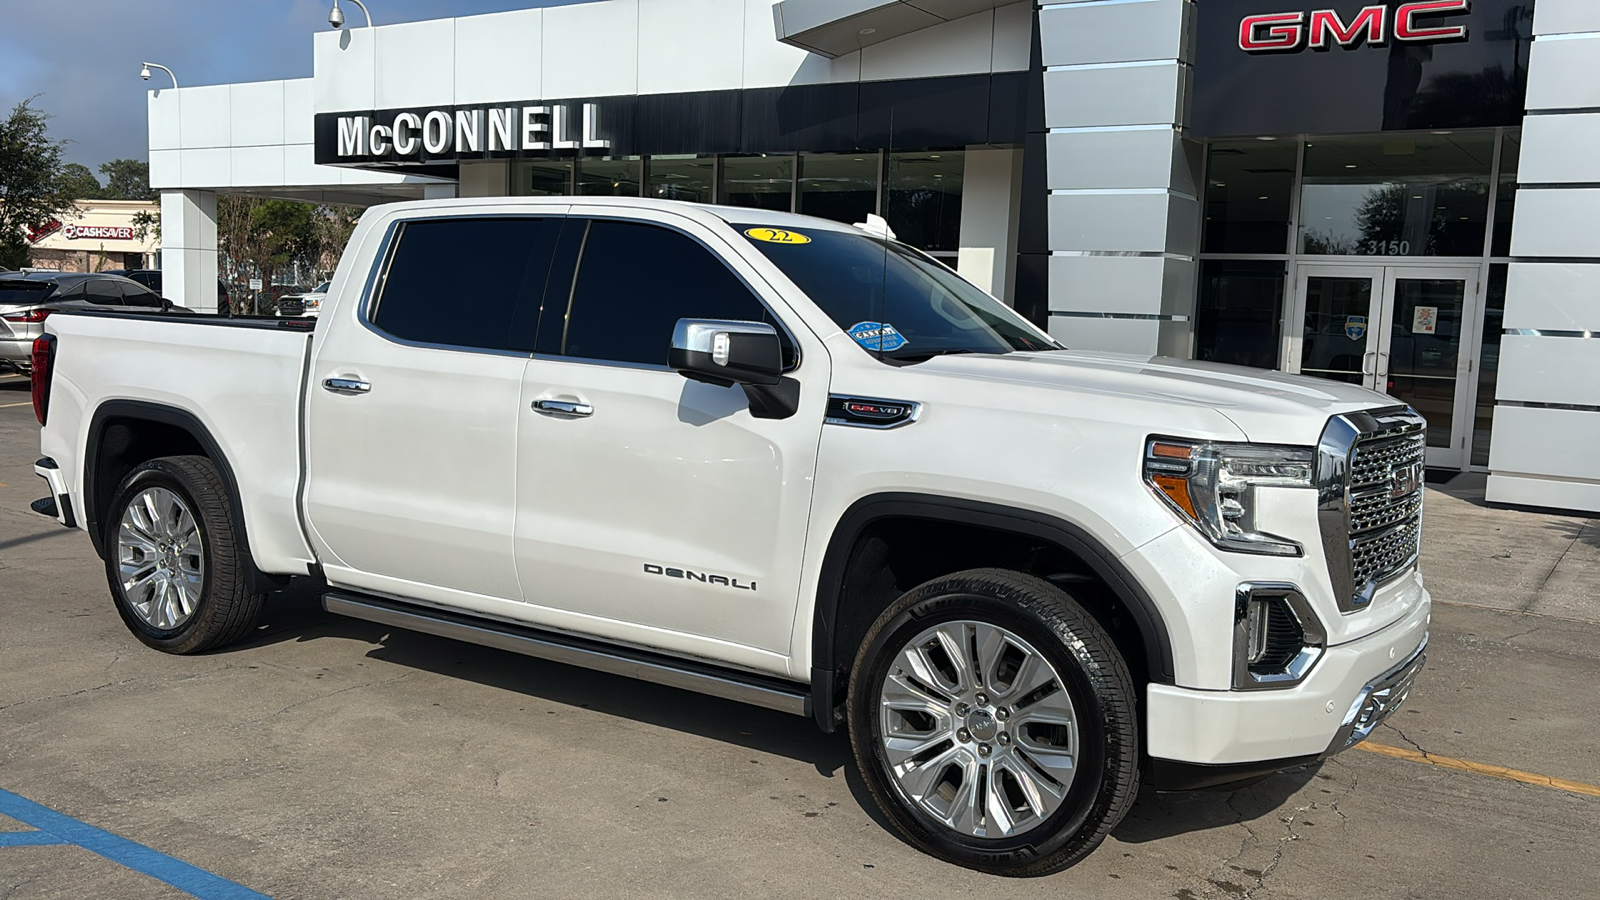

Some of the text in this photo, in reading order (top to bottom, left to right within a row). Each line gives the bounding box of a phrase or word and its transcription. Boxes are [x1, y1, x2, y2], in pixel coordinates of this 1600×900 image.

[1238, 0, 1467, 51] GMC
[337, 103, 610, 157] McCONNELL
[765, 229, 793, 242] 22
[1367, 240, 1410, 255] 3150
[643, 563, 757, 591] DENALI
